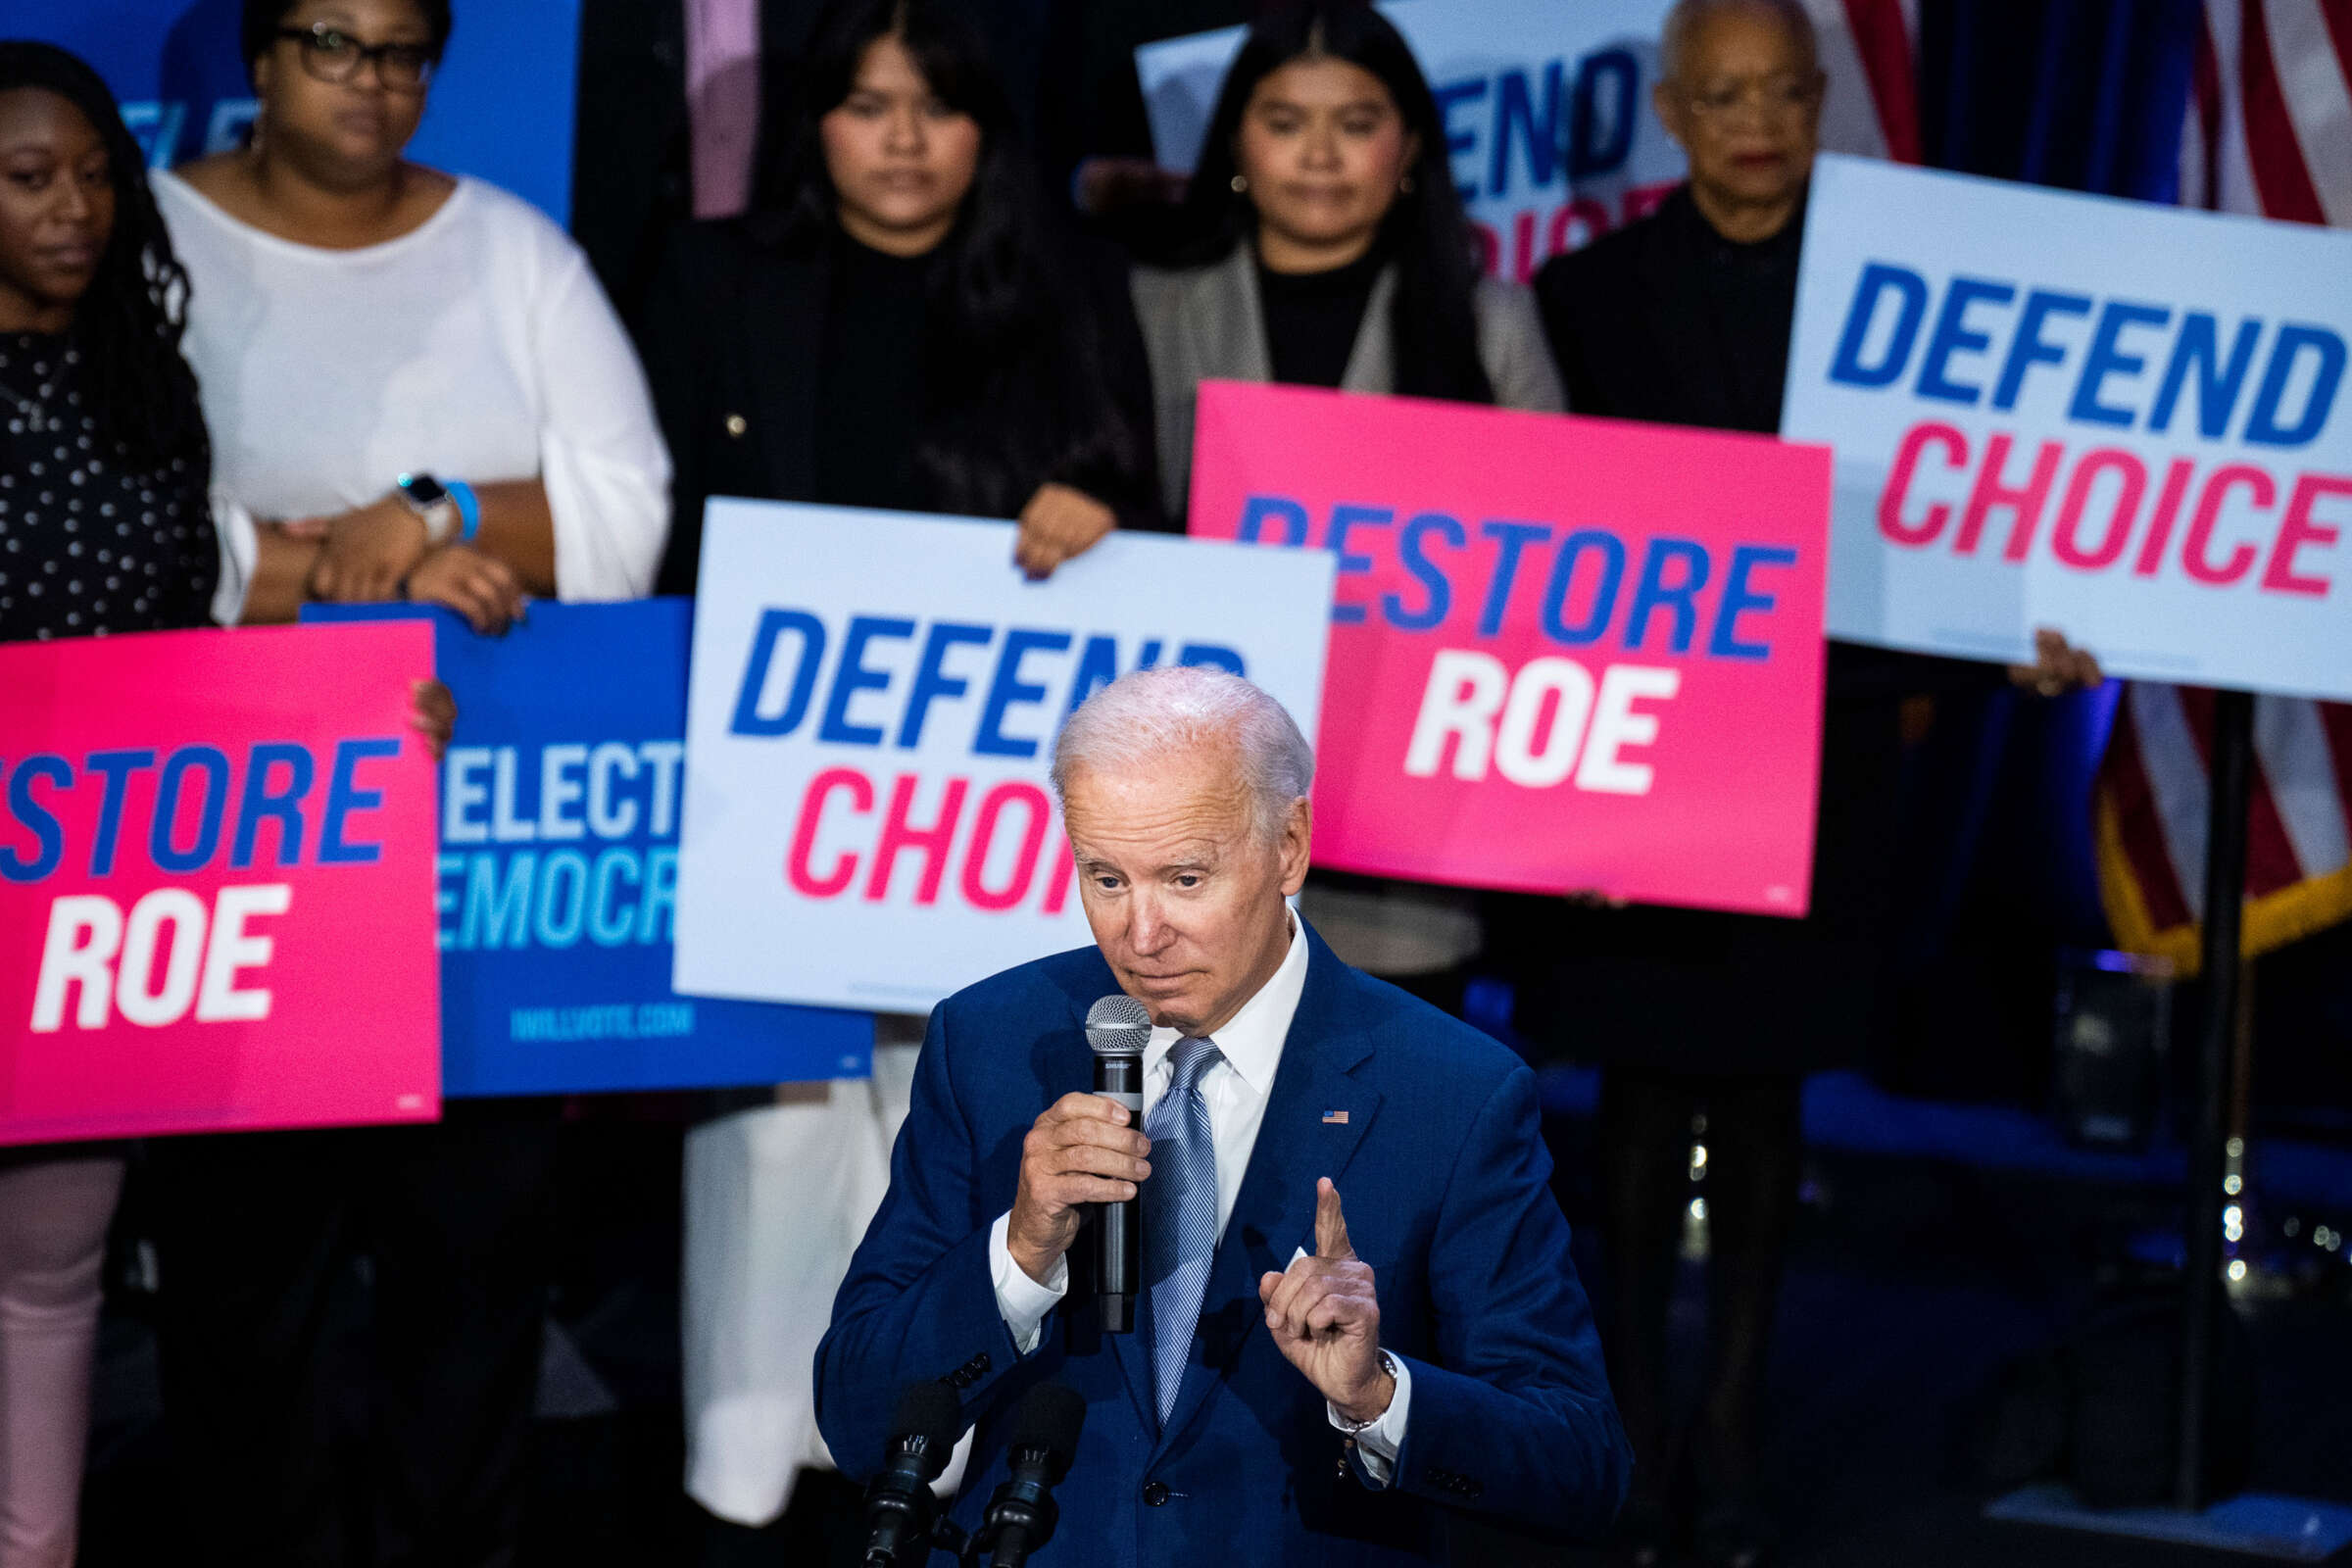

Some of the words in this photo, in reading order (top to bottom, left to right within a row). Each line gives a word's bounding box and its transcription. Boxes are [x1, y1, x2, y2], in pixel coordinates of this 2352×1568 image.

[1827, 260, 2349, 451] DEFEND
[1877, 419, 2352, 598] CHOICE
[727, 607, 1246, 760] DEFEN
[1403, 649, 1681, 796] ROE
[0, 739, 401, 884] STORE
[443, 740, 685, 844] ELECT
[30, 883, 293, 1032] ROE
